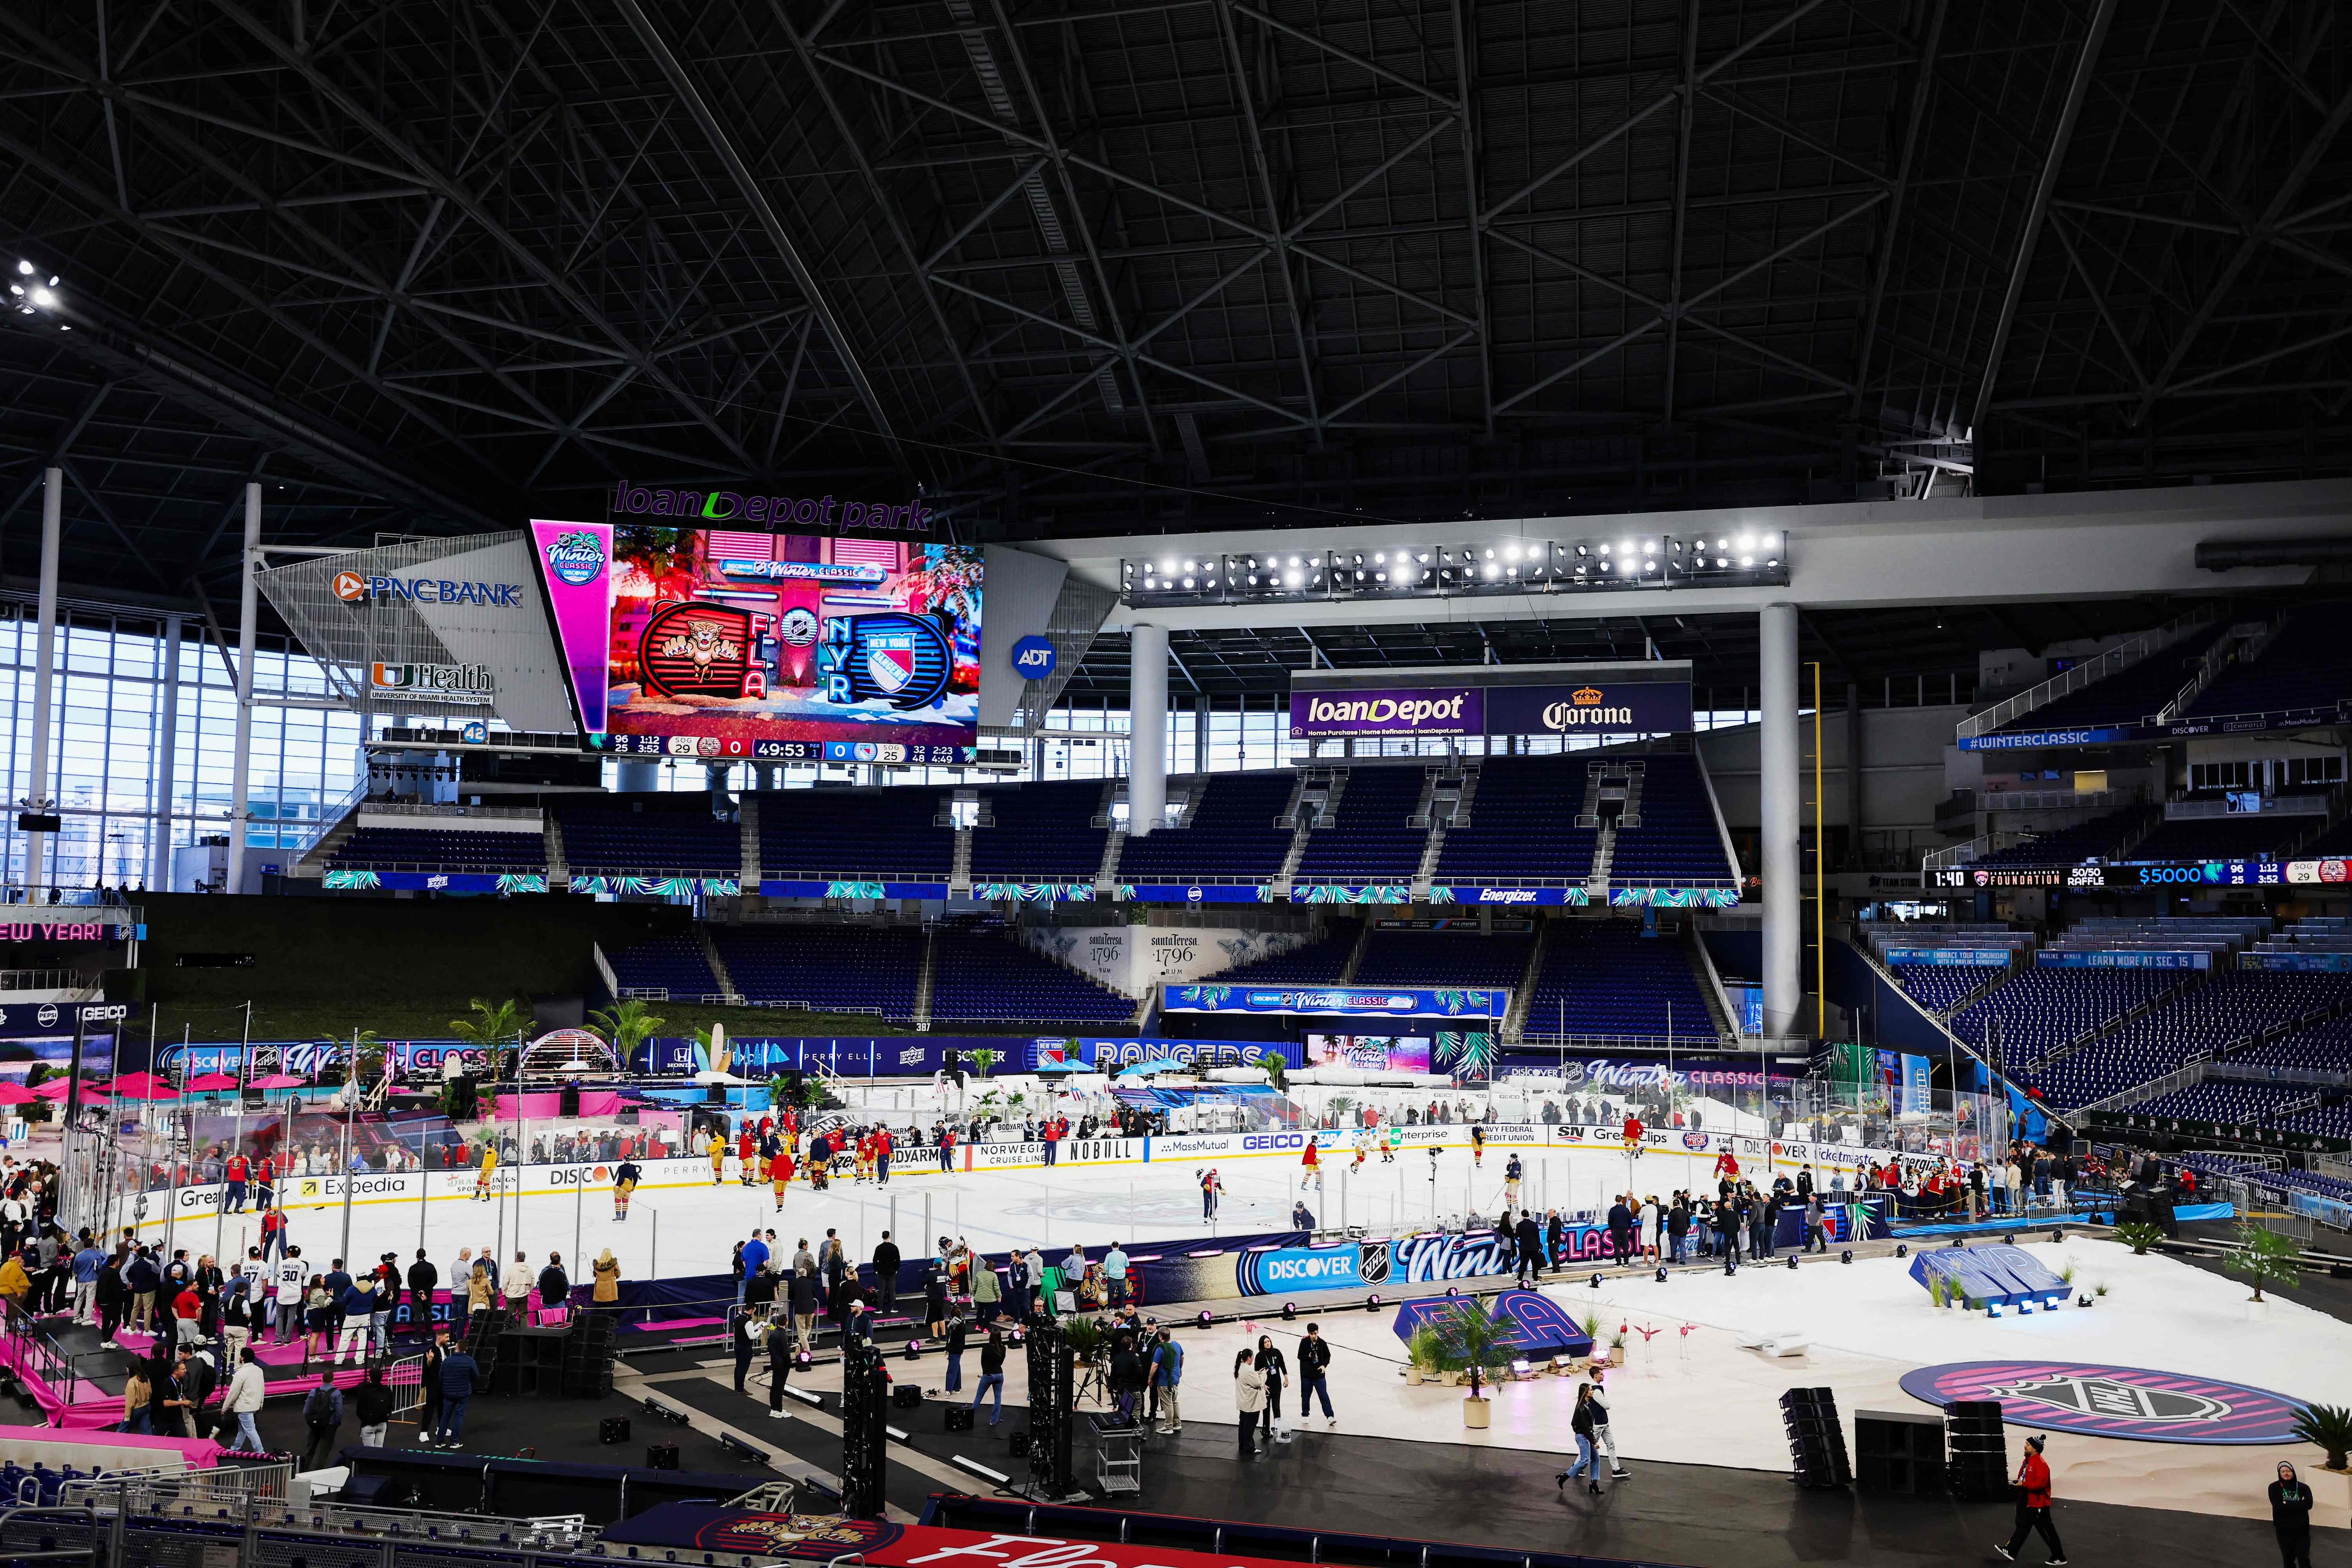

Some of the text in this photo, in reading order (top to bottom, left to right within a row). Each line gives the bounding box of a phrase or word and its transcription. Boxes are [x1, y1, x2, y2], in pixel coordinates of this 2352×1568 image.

[615, 480, 931, 534] loanDepot park
[546, 544, 605, 565] Winter
[767, 562, 817, 579] Winter
[818, 567, 858, 577] CLASSIC
[436, 580, 521, 607] BANK
[793, 622, 806, 635] NHL
[870, 638, 910, 648] NEW YORK
[1017, 650, 1052, 666] ADT
[872, 651, 907, 681] RANGERS
[1308, 695, 1463, 726] loanDepot
[1542, 702, 1633, 732] Corona
[465, 725, 485, 740] 42
[2172, 725, 2209, 735] DISCOVER
[2285, 717, 2320, 726] MassMutual
[615, 735, 660, 744] 96 1:12
[1970, 732, 2090, 749] #WINTERCLASSIC
[615, 744, 660, 753] 25 3:52
[675, 744, 690, 753] 29
[730, 741, 741, 753] 0
[758, 743, 804, 756] 49:53
[835, 745, 846, 757] 0
[914, 746, 953, 755] 32 2:23
[884, 752, 898, 761] 25
[931, 755, 953, 764] 4:49
[2072, 868, 2101, 877] 50/50
[2230, 864, 2278, 873] 96 1:12
[1882, 878, 1899, 887] TEAM
[1935, 872, 1964, 886] 1:40
[1990, 875, 2059, 885] FOUNDATION
[2068, 877, 2104, 886] RAFFLE
[2139, 868, 2201, 884] $5000
[2232, 875, 2278, 884] 25 3:52
[2297, 873, 2310, 881] 29
[40, 923, 103, 940] YEAR!
[2088, 955, 2188, 967] LEARN MORE AT SEC. 15
[2242, 961, 2262, 969] 25%
[1294, 993, 1344, 1011] Winter
[83, 1005, 127, 1021] GEICO
[916, 1023, 931, 1032] 387
[1343, 1047, 1388, 1068] Winter
[1512, 1067, 1767, 1085] DISCOVER NHL CLASSIC
[1391, 1130, 1448, 1140] enterprise
[1686, 1131, 1705, 1140] Jersey
[1173, 1139, 1229, 1152] MassMutual
[1243, 1134, 1303, 1150] GEICO
[1318, 1132, 1336, 1145] SAP
[981, 1144, 1046, 1155] NORWEGIA
[1071, 1140, 1130, 1161] NOBULL
[1745, 1139, 1807, 1159] DISCOVER
[990, 1156, 1022, 1164] CRUISE
[664, 1165, 707, 1175] PERRY
[326, 1177, 405, 1197] Expedia
[1271, 1250, 1385, 1280] DISCOVER NHL
[283, 1271, 298, 1281] 30
[2089, 1385, 2139, 1415] NHL
